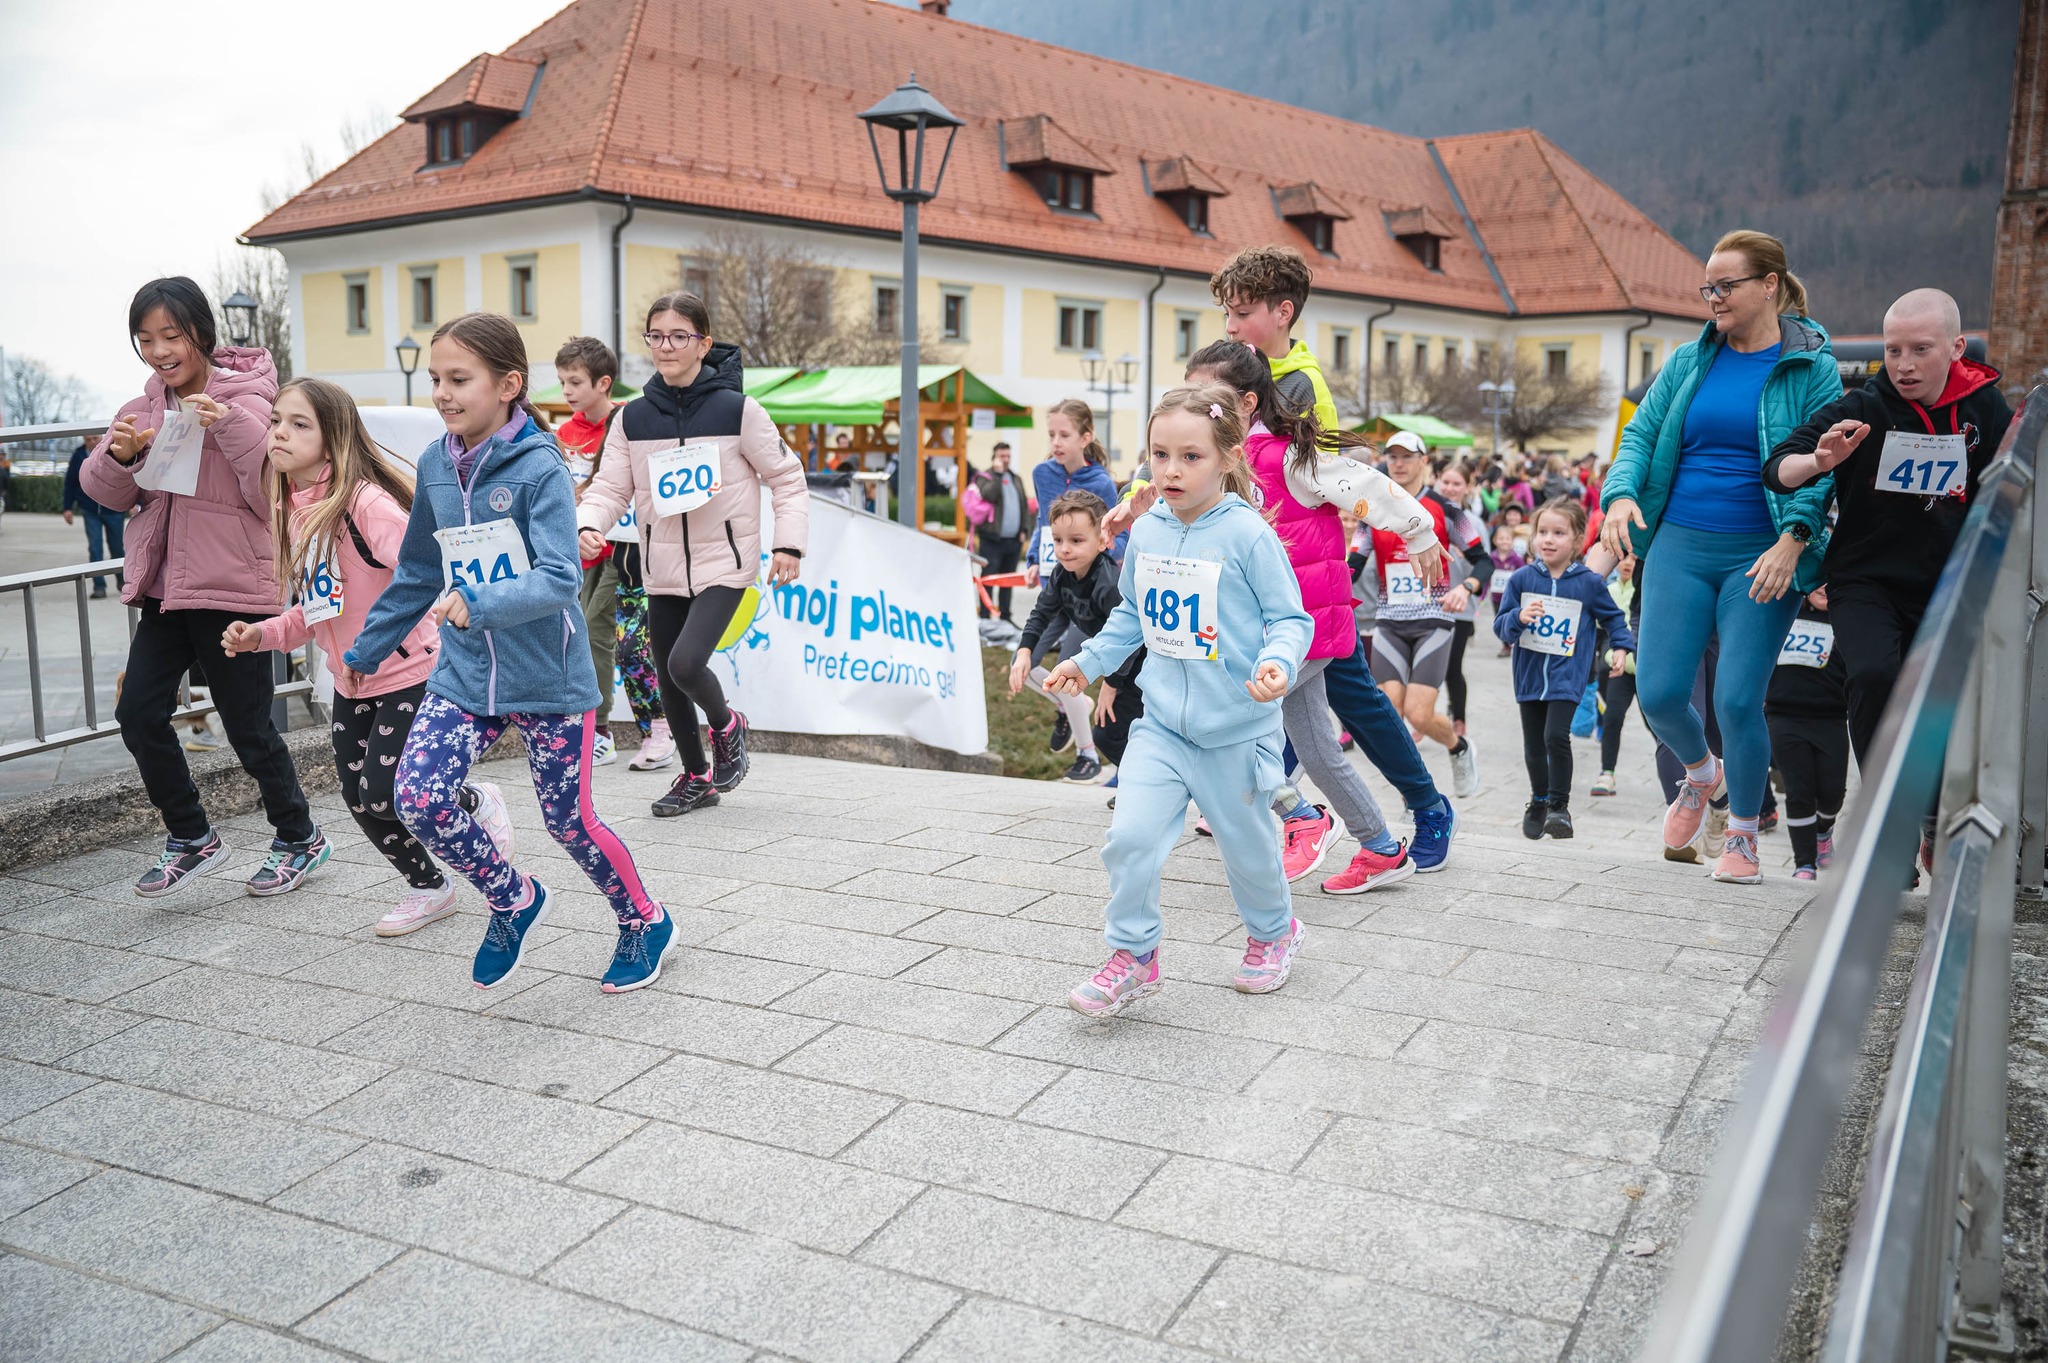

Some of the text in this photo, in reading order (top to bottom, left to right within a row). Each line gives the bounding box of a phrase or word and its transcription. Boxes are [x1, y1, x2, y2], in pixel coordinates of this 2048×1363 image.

[658, 464, 713, 499] 620
[1888, 459, 1958, 491] 417
[450, 553, 518, 586] 514
[1392, 577, 1424, 593] 233
[771, 579, 955, 652] moj planet
[1144, 588, 1200, 633] 481
[1784, 634, 1826, 654] 225
[804, 644, 956, 699] Pretecimo ga!
